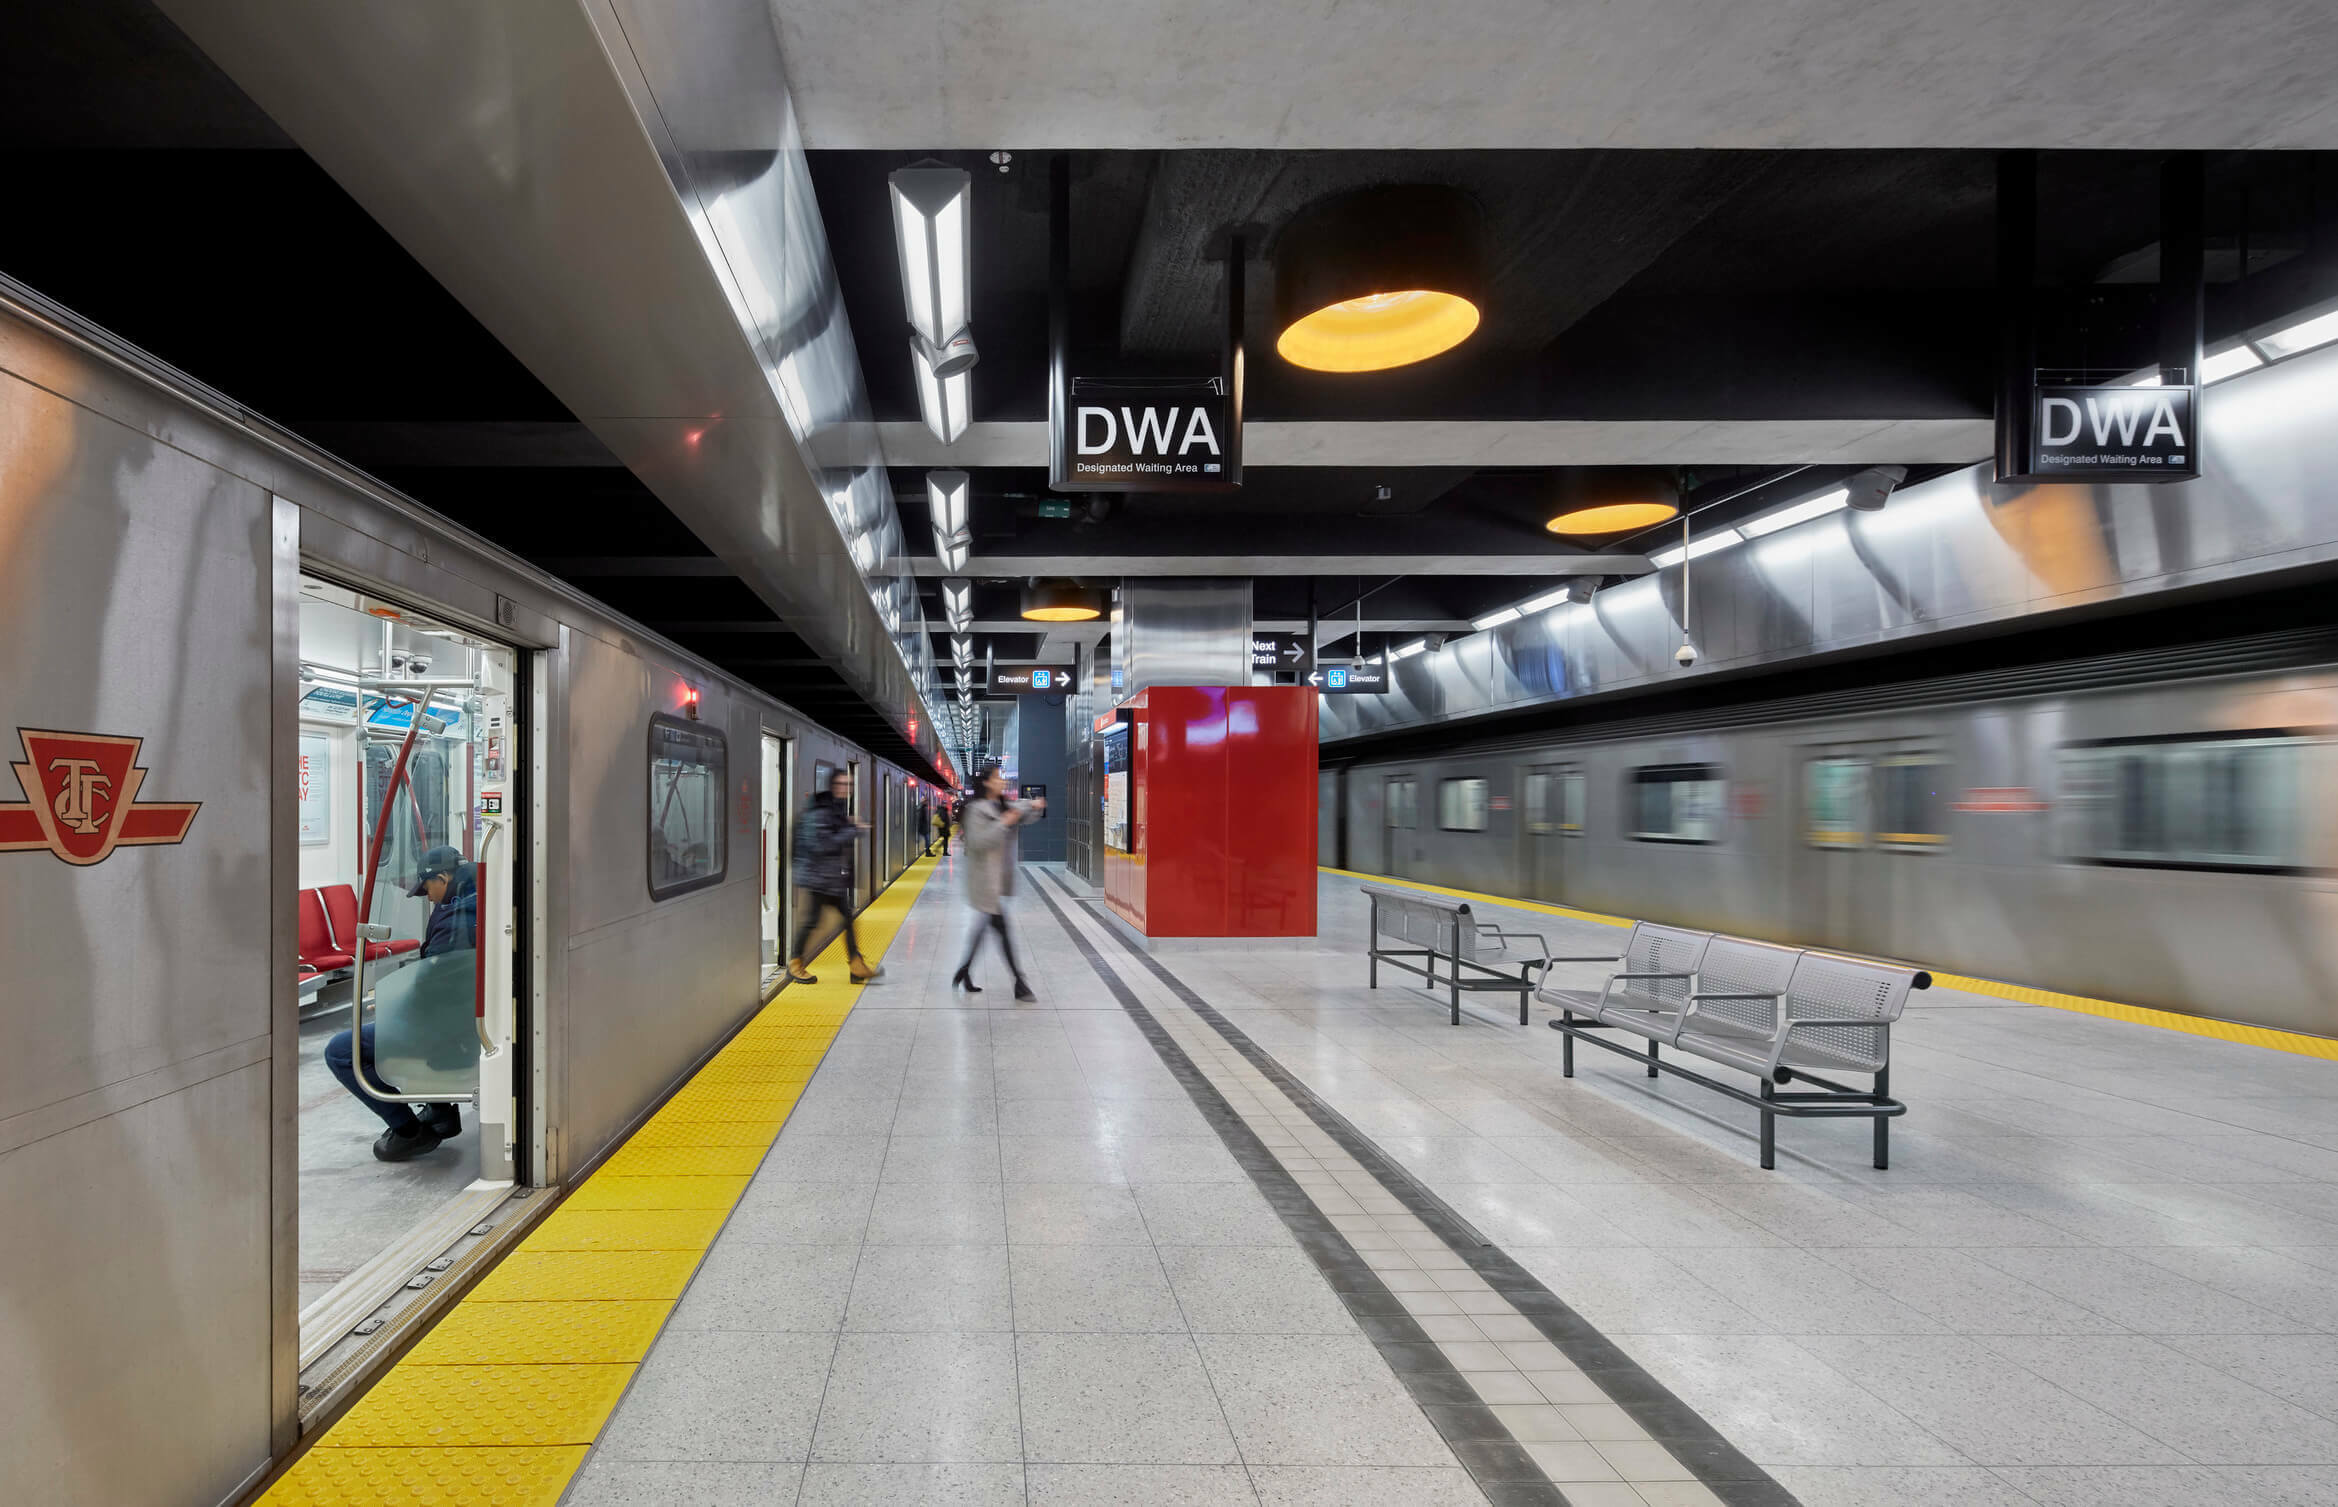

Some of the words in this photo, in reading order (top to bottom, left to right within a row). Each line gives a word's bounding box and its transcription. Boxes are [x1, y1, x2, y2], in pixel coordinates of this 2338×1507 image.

[2041, 397, 2186, 447] DWA
[1077, 406, 1221, 455] DWA
[2041, 454, 2098, 466] Designated
[2100, 454, 2137, 466] Waiting
[2139, 454, 2163, 465] Area
[1077, 463, 1133, 474] Designated
[1135, 463, 1172, 474] Waiting
[1174, 463, 1198, 472] Area
[1251, 641, 1276, 651] Next
[1251, 653, 1277, 664] Train
[998, 675, 1029, 683] Elevator
[1349, 674, 1380, 682] Elevator
